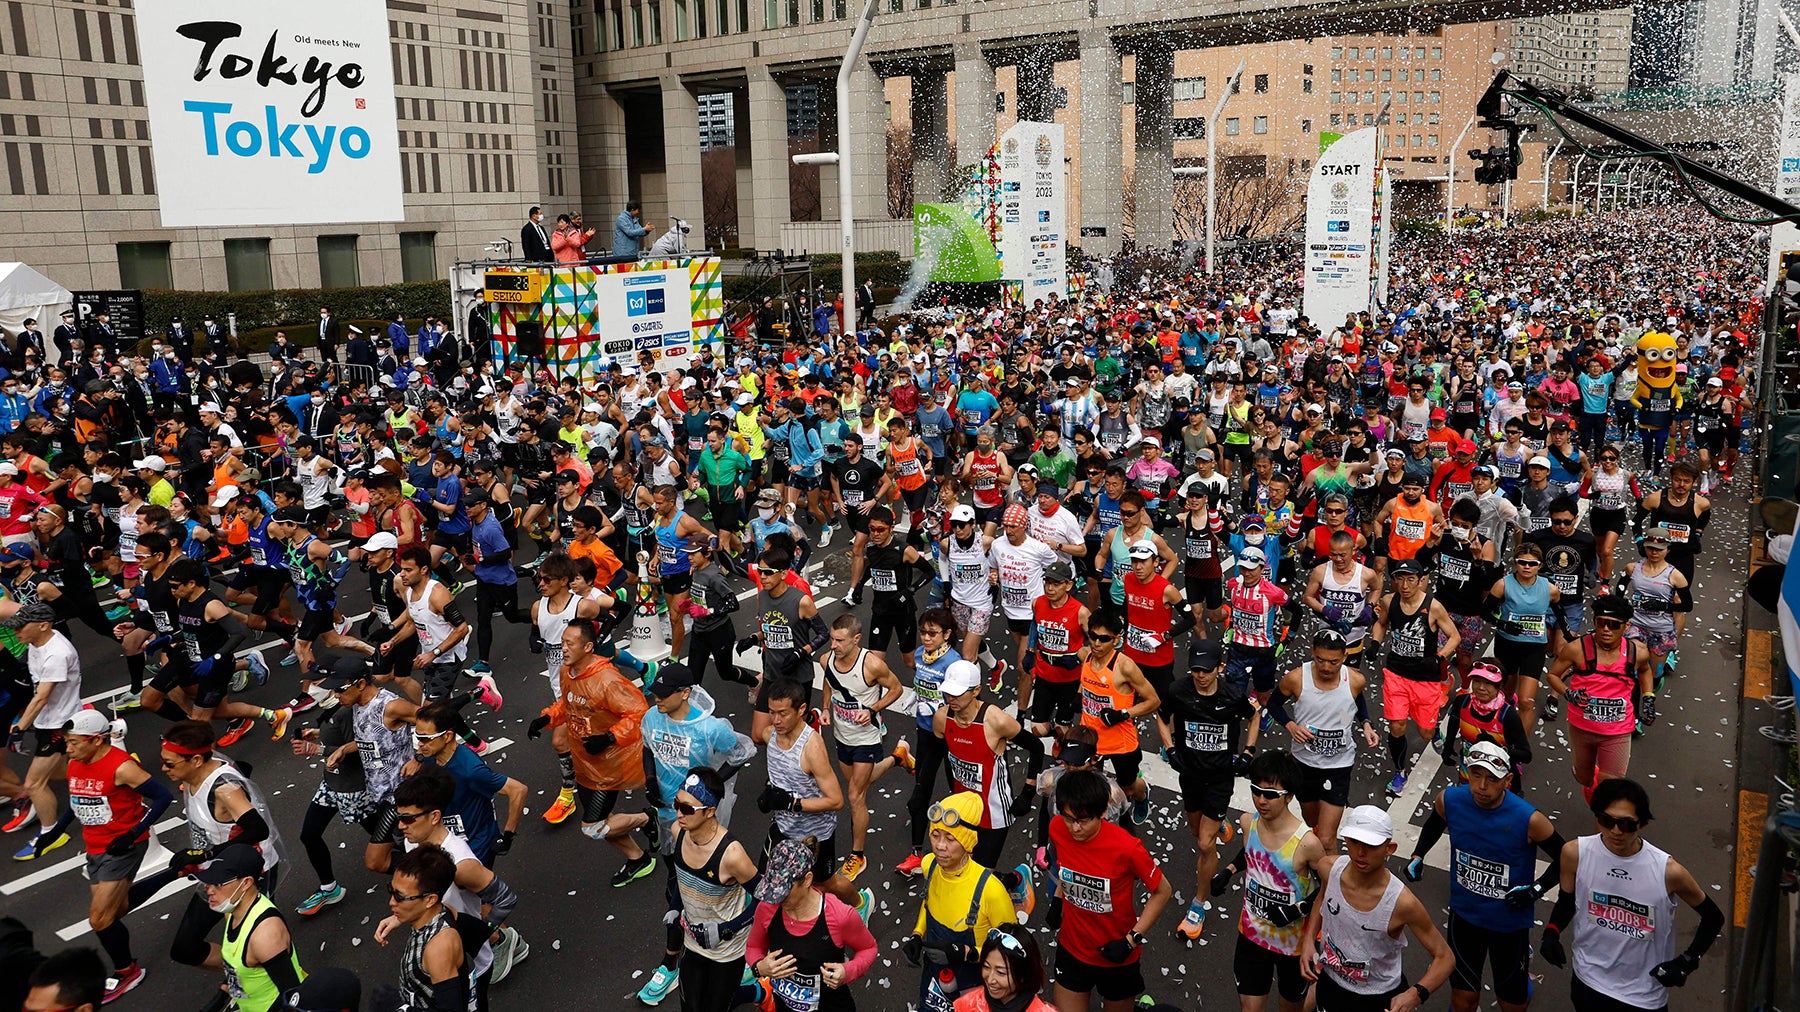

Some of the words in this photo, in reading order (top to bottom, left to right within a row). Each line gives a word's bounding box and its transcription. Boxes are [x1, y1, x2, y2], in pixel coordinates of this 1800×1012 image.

[294, 34, 311, 45] Old
[314, 38, 340, 48] meets
[342, 39, 361, 49] New
[176, 21, 365, 118] Tokyo
[183, 100, 371, 174] Tokyo
[1035, 172, 1052, 180] TOKYO
[1321, 164, 1361, 176] START
[1035, 187, 1053, 198] 2023
[492, 291, 523, 302] SEIKO
[78, 303, 92, 320] P
[640, 320, 664, 333] STARTS
[607, 340, 631, 349] TOKIO
[644, 338, 660, 347] asics
[762, 611, 772, 621] TOP
[772, 610, 789, 625] GEAR
[1193, 733, 1219, 744] 20147
[1471, 859, 1502, 873] 東京メトロ
[1074, 874, 1103, 888] 東京メトロ
[1464, 867, 1496, 887] 20074
[1069, 884, 1100, 901] 61695
[1259, 887, 1289, 901] 東京メトロ
[1610, 898, 1646, 913] 東京メトロ
[1602, 905, 1640, 927] 70008
[1608, 920, 1646, 939] STARTS
[778, 979, 806, 1001] 8626
